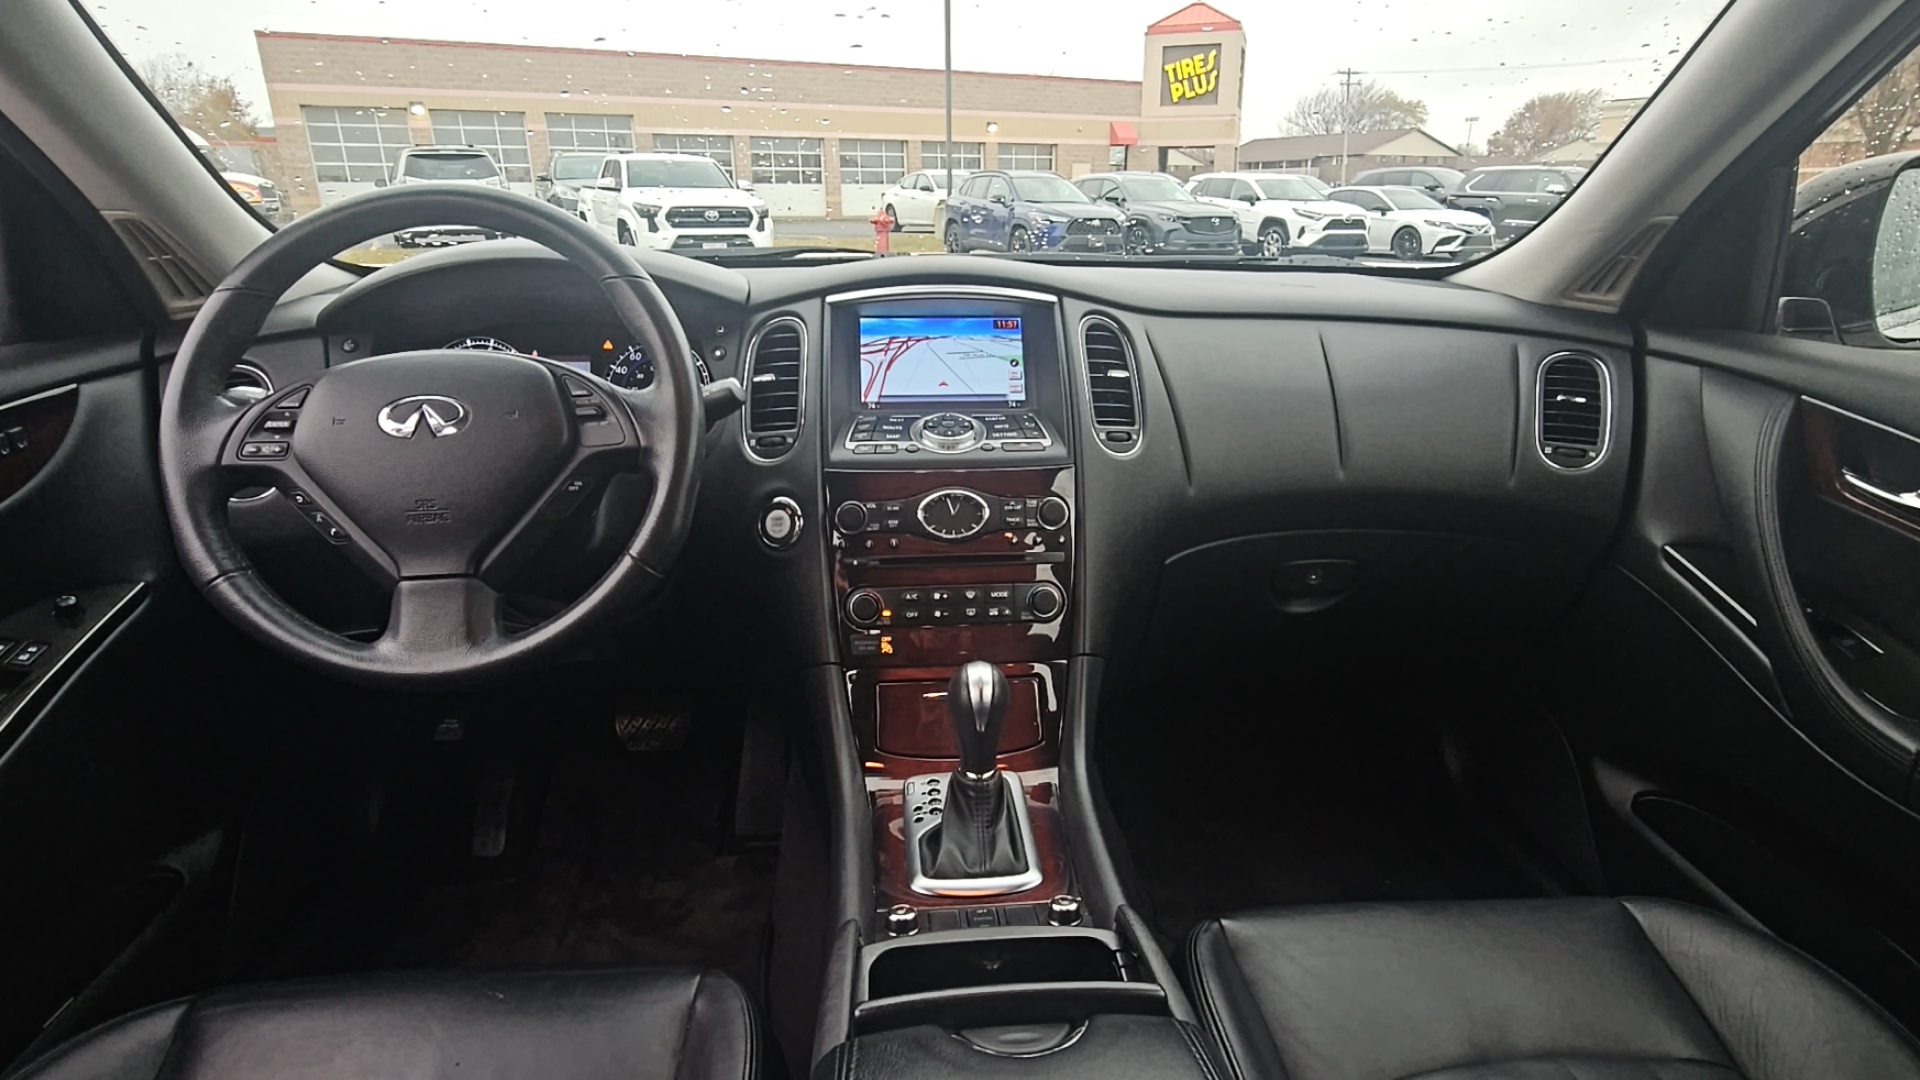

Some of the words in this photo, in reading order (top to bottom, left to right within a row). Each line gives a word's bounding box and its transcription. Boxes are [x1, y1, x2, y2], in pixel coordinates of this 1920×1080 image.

[1164, 49, 1217, 83] TIRES
[1170, 69, 1218, 103] PLUS
[629, 352, 642, 361] 60
[615, 365, 628, 375] 40
